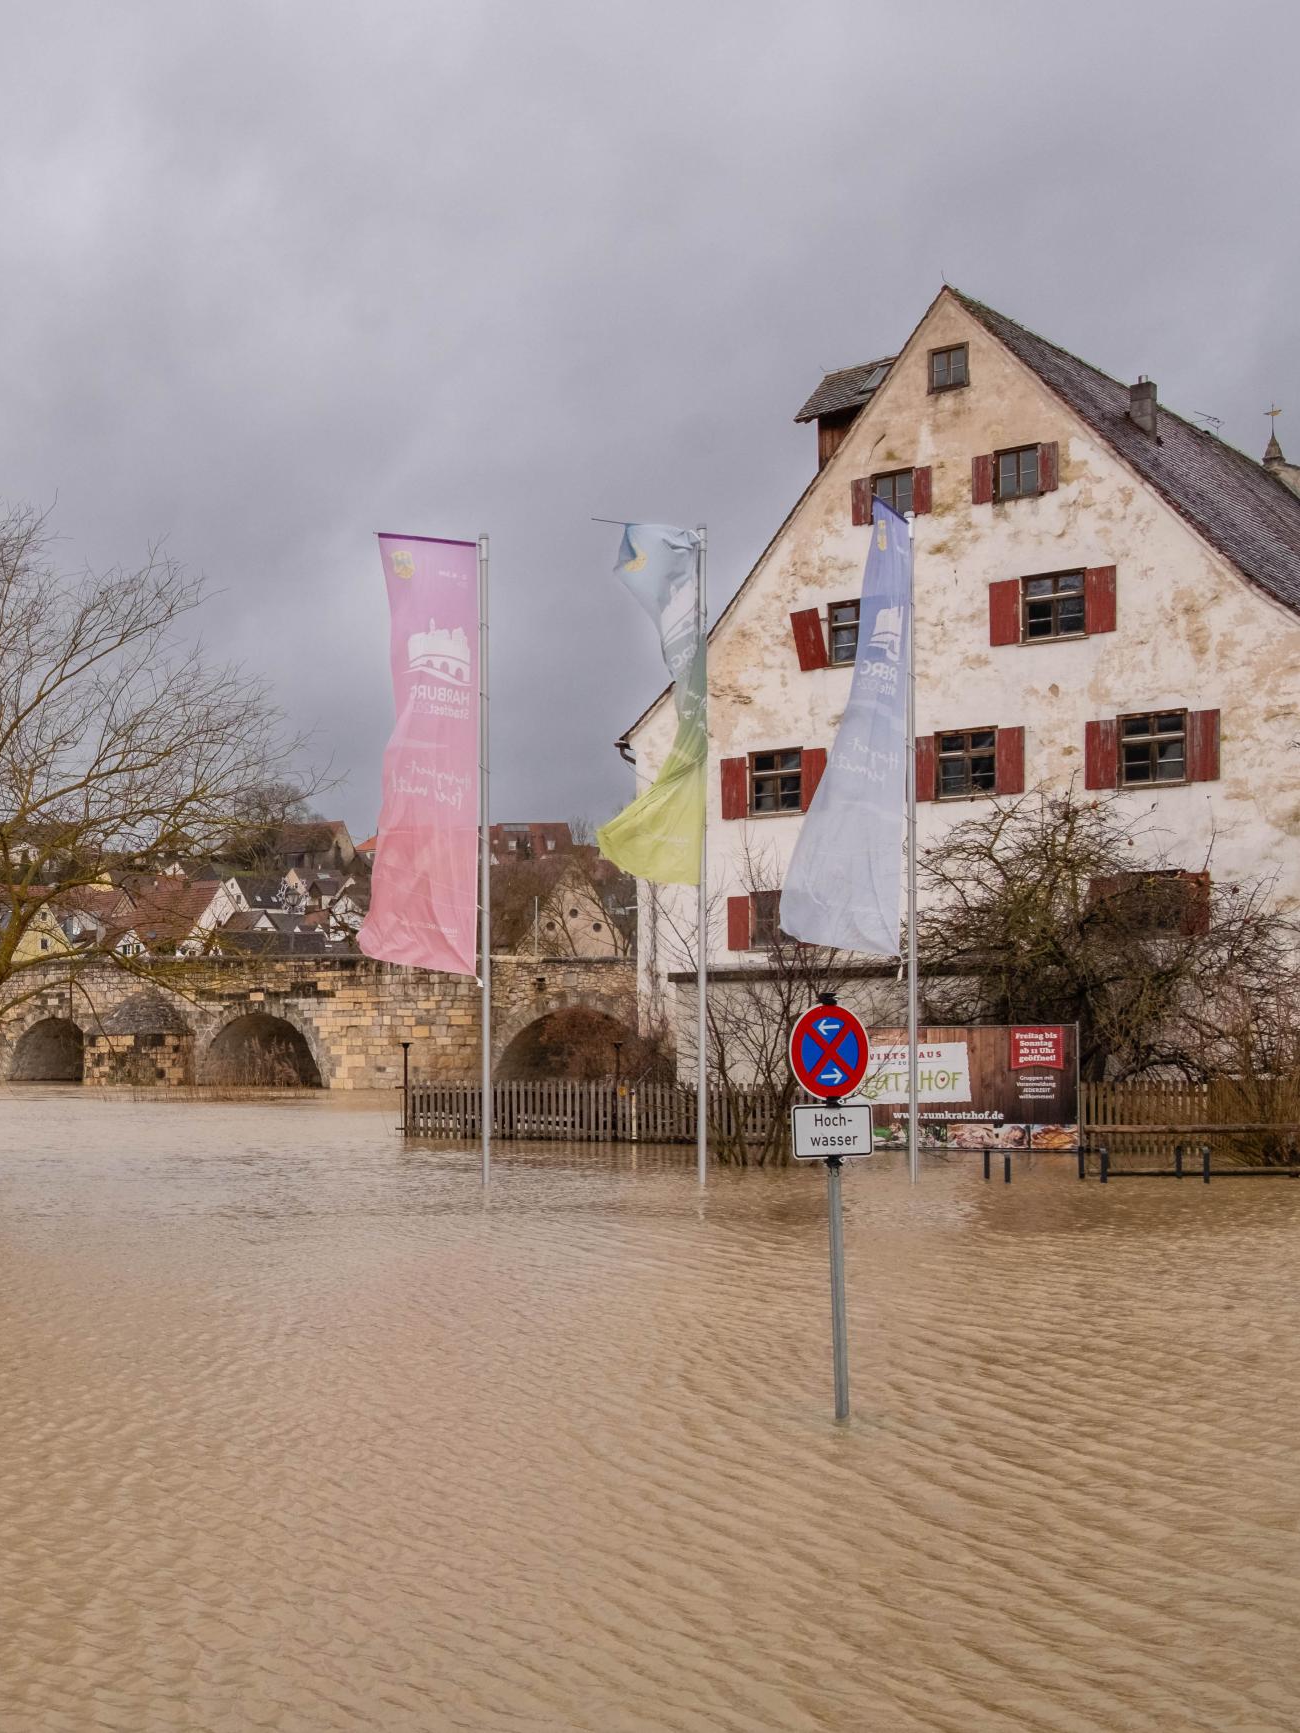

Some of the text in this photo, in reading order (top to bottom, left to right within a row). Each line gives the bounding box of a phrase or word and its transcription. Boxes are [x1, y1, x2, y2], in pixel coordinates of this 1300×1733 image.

[1015, 1032, 1044, 1040] Freitag
[1019, 1055, 1056, 1063] geöffnet!
[814, 1113, 853, 1127] Hoch-
[892, 1110, 1005, 1120] ww.zumkratzhof.de
[810, 1135, 858, 1147] wasser
